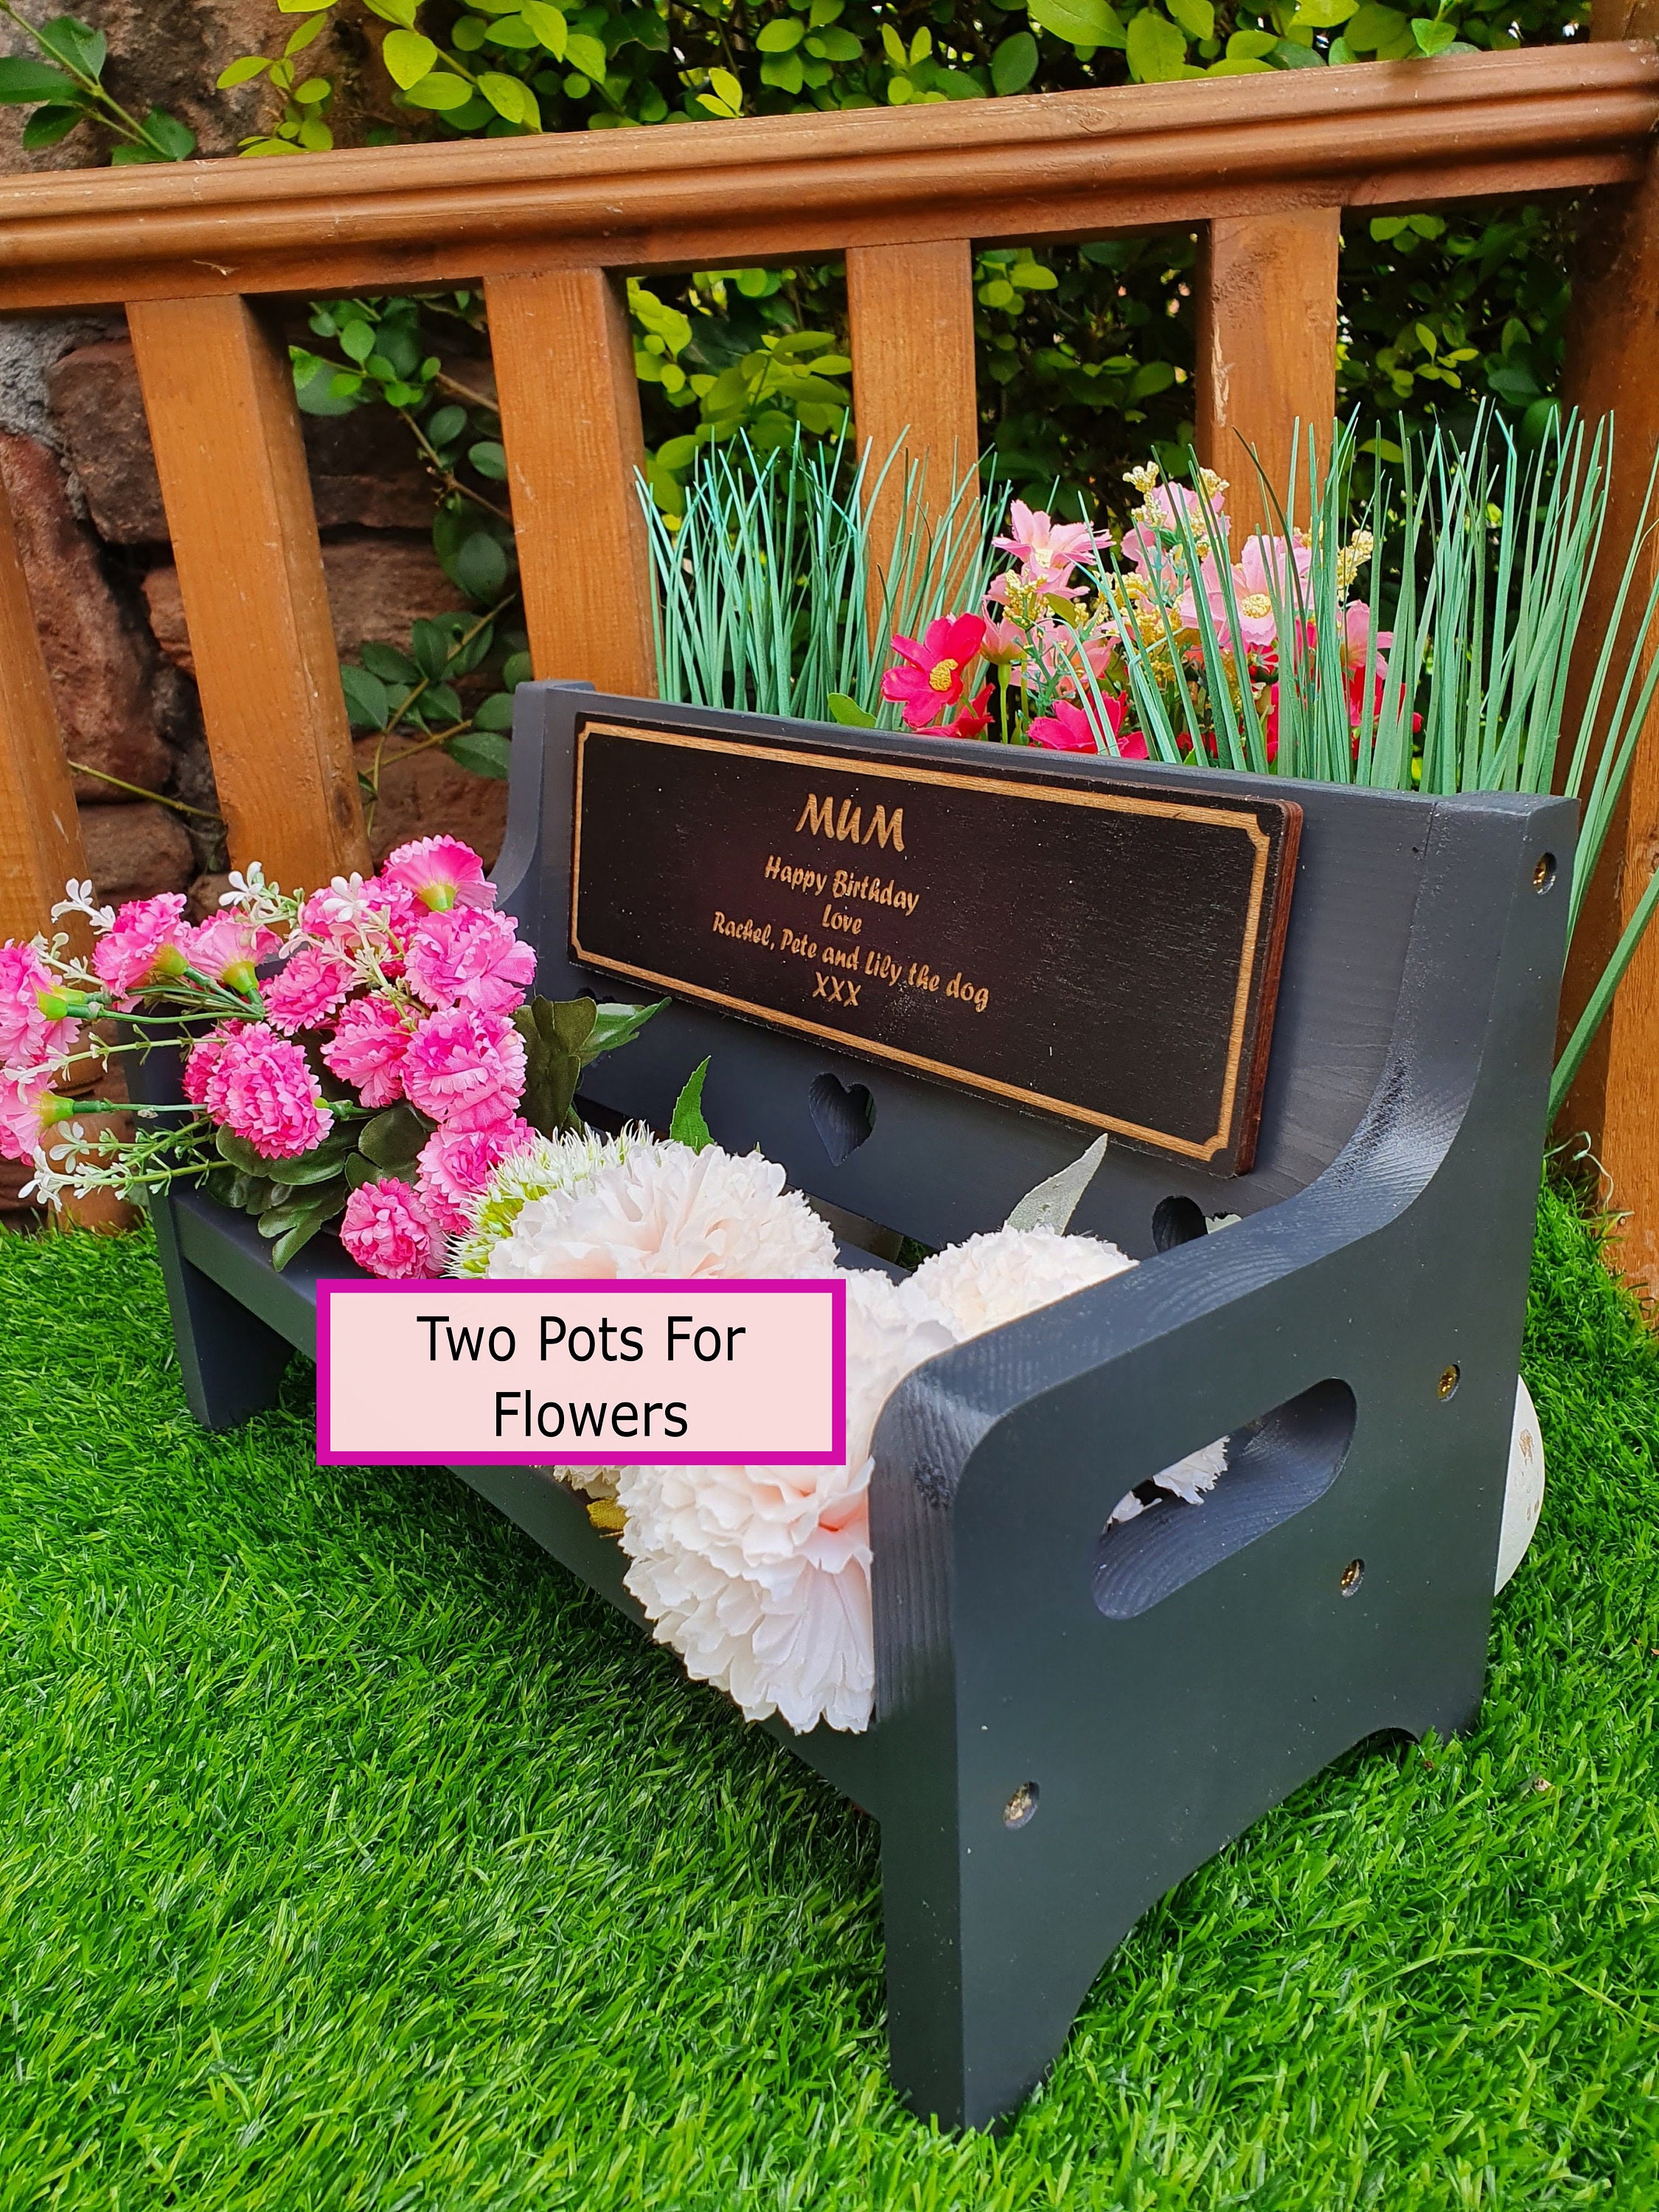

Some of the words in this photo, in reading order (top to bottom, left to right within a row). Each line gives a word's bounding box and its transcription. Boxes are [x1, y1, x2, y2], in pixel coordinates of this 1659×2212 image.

[795, 793, 905, 852] MUM
[764, 855, 827, 896] Happy
[832, 869, 919, 916] Birthday
[821, 904, 862, 934] Love
[712, 911, 775, 950] Rachel,
[779, 928, 817, 959] Pete
[822, 946, 860, 970] and
[864, 950, 902, 986] Lily
[908, 961, 940, 992] the
[945, 973, 990, 1012] dog
